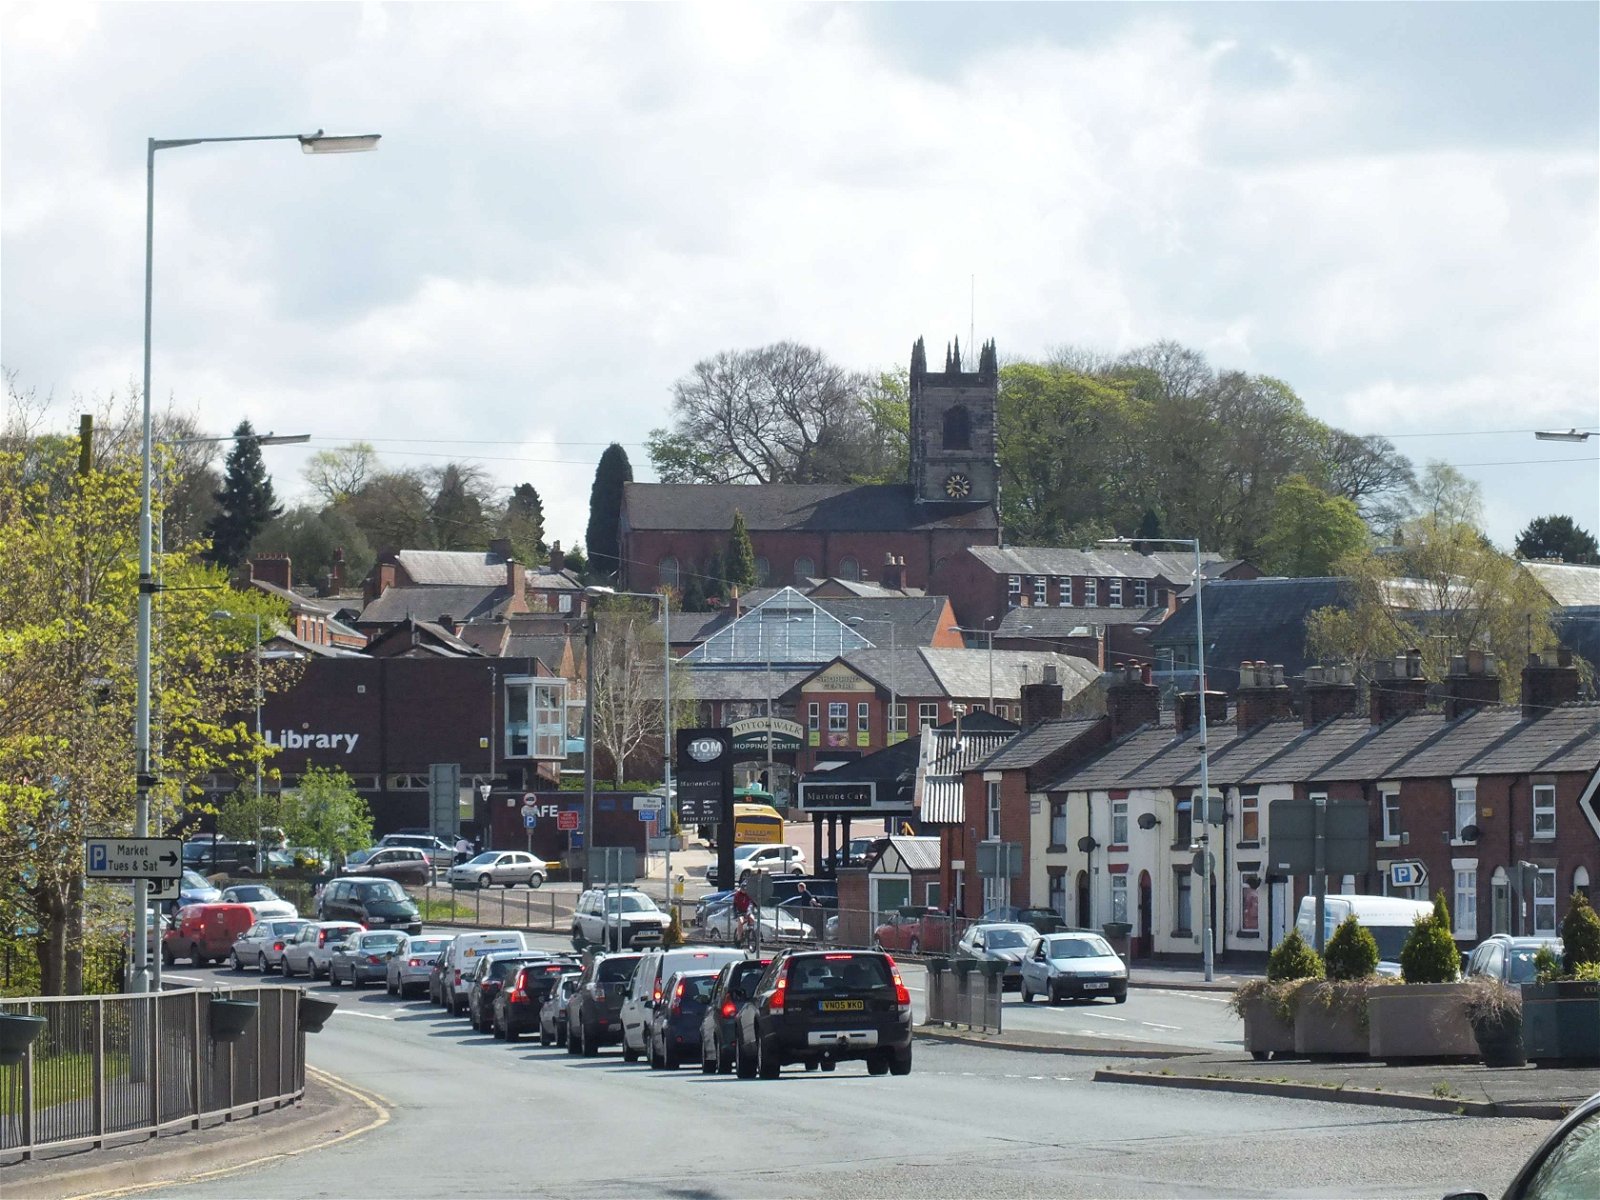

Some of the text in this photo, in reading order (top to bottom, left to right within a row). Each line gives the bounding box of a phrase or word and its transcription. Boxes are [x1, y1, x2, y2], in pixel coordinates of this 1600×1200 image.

[733, 720, 802, 735] APITOL WALK
[264, 729, 360, 754] Library
[691, 741, 721, 753] TOM
[847, 792, 868, 800] Cars
[533, 804, 559, 818] AFE
[526, 816, 534, 827] P
[117, 844, 149, 856] Market
[93, 846, 104, 869] P
[108, 860, 158, 872] Tues & Sat
[1397, 868, 1408, 882] P
[824, 1001, 846, 1010] VN05
